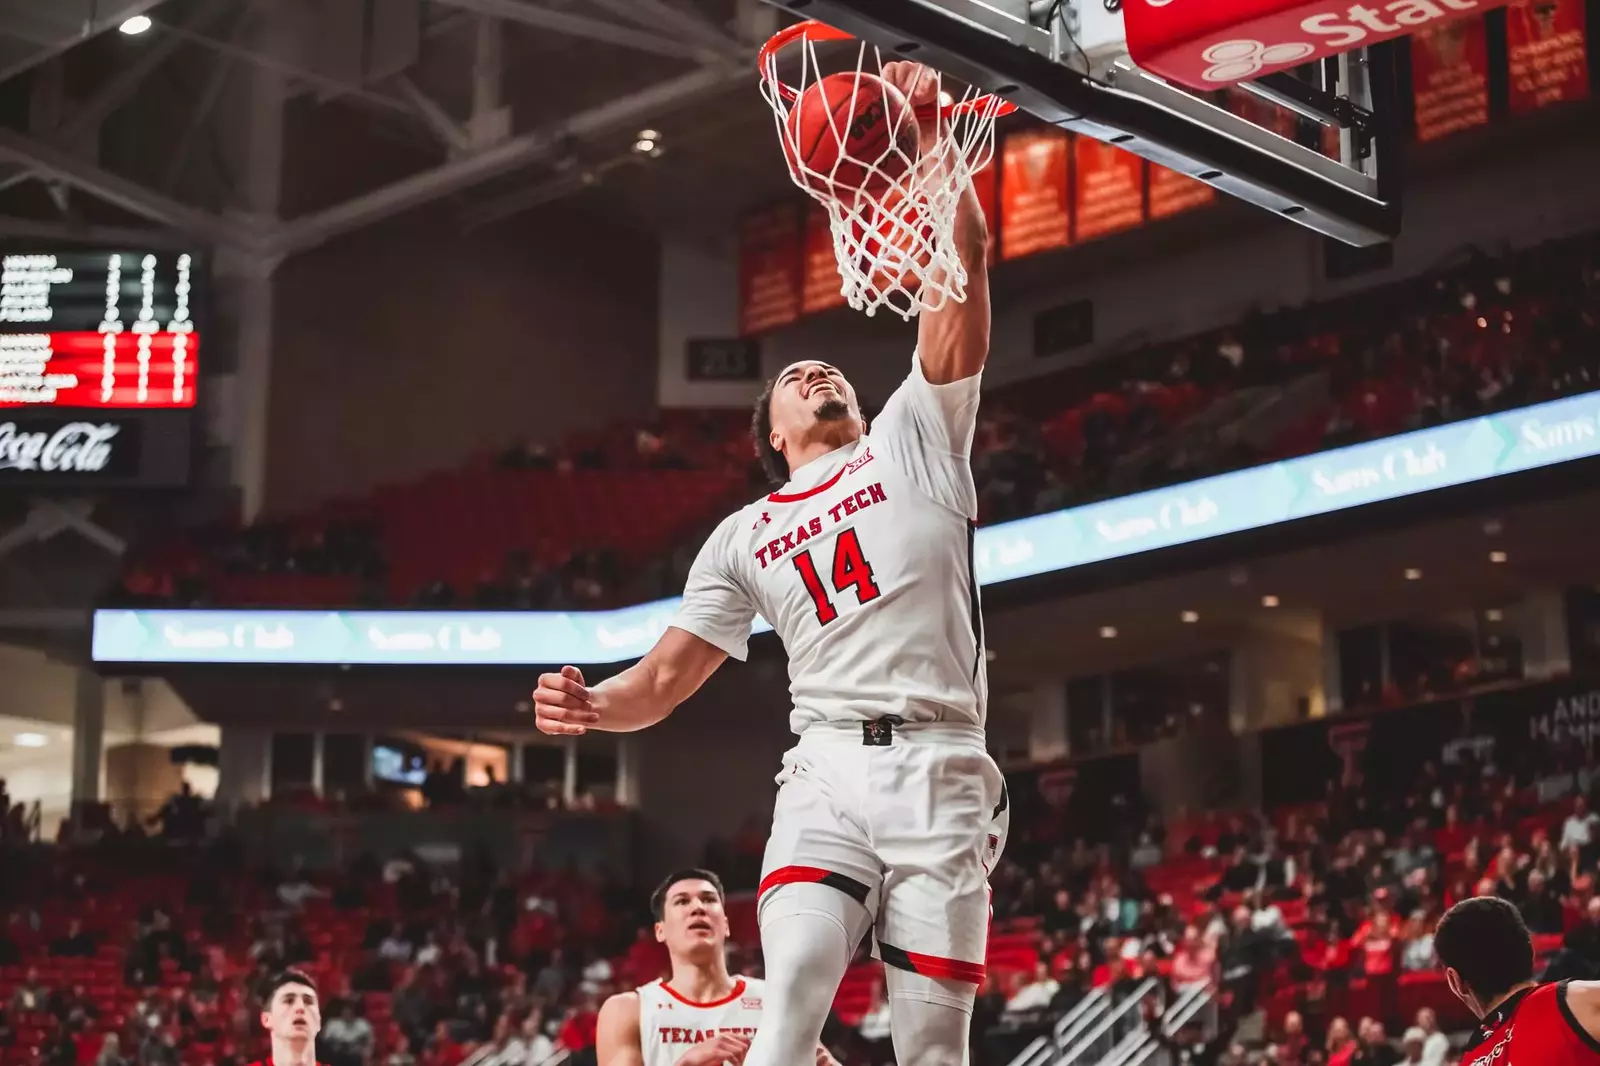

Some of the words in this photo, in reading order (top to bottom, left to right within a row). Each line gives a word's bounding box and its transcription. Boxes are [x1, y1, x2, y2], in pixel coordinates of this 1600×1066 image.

[755, 517, 823, 569] TEXAS
[828, 482, 887, 523] TECH
[792, 526, 881, 627] 14
